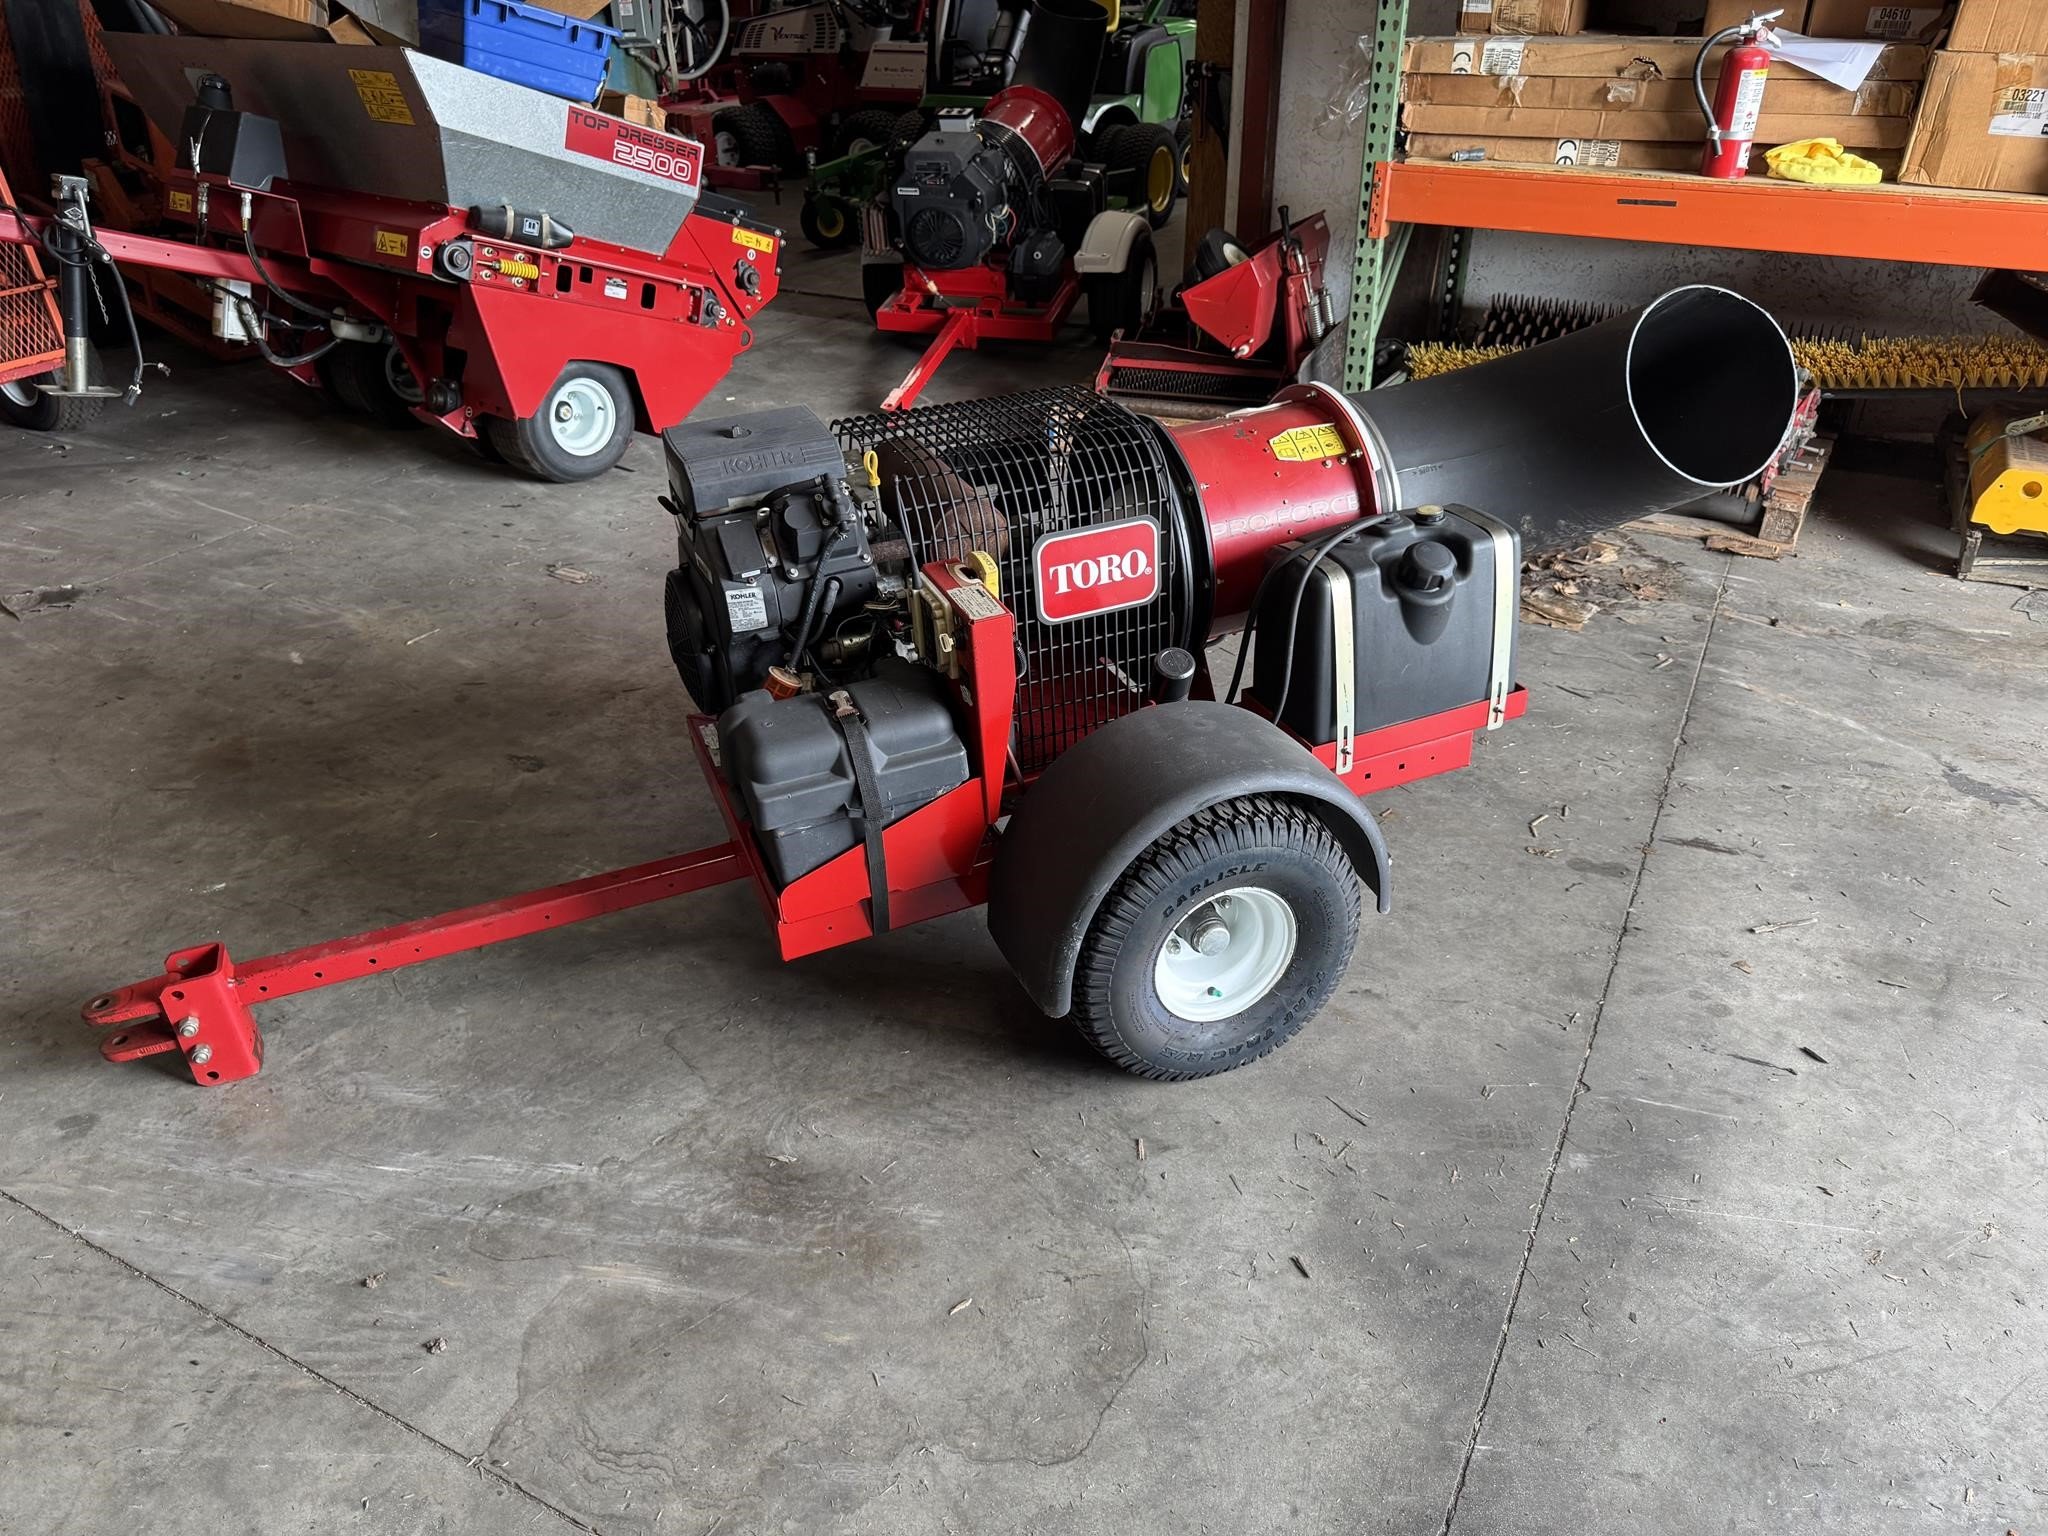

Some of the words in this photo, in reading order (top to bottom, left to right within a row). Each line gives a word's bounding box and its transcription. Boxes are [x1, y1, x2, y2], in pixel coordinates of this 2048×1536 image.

[1880, 7, 1912, 20] 04610
[1508, 49, 1521, 70] 07342
[2012, 88, 2046, 102] 03221
[571, 110, 610, 131] TOP
[617, 125, 698, 160] DRESSER
[613, 139, 692, 181] 2500
[1606, 141, 1619, 162] 07342
[721, 448, 794, 475] KOHLER
[730, 592, 757, 600] KOHLER
[1162, 862, 1267, 918] CARLISLE
